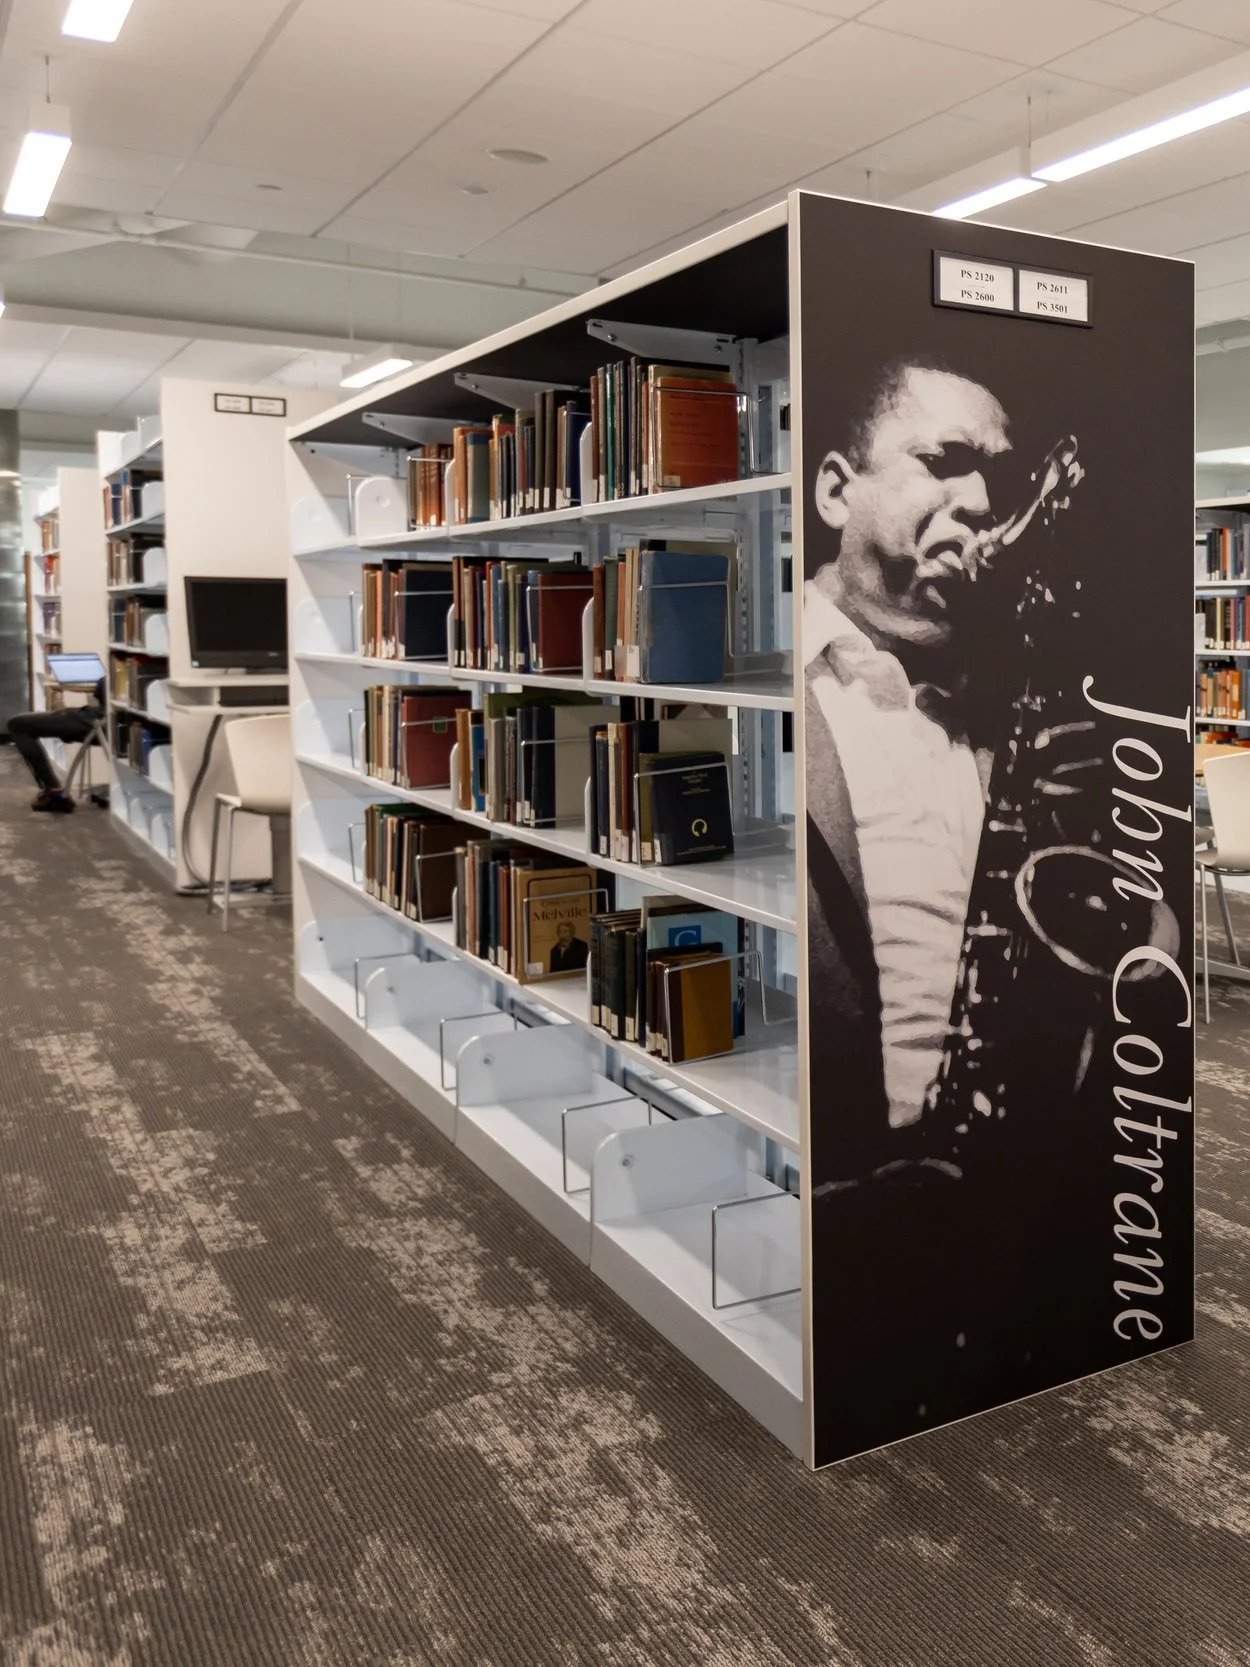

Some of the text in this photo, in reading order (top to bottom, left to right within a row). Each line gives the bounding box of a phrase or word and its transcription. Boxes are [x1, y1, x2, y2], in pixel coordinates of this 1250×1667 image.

[961, 269, 995, 282] PS 2120
[1037, 281, 1068, 294] PS 2611
[961, 289, 995, 302] PS 2600
[1037, 301, 1068, 314] PS 3501
[533, 906, 588, 921] Melville
[1082, 675, 1192, 1341] John Coltrane
